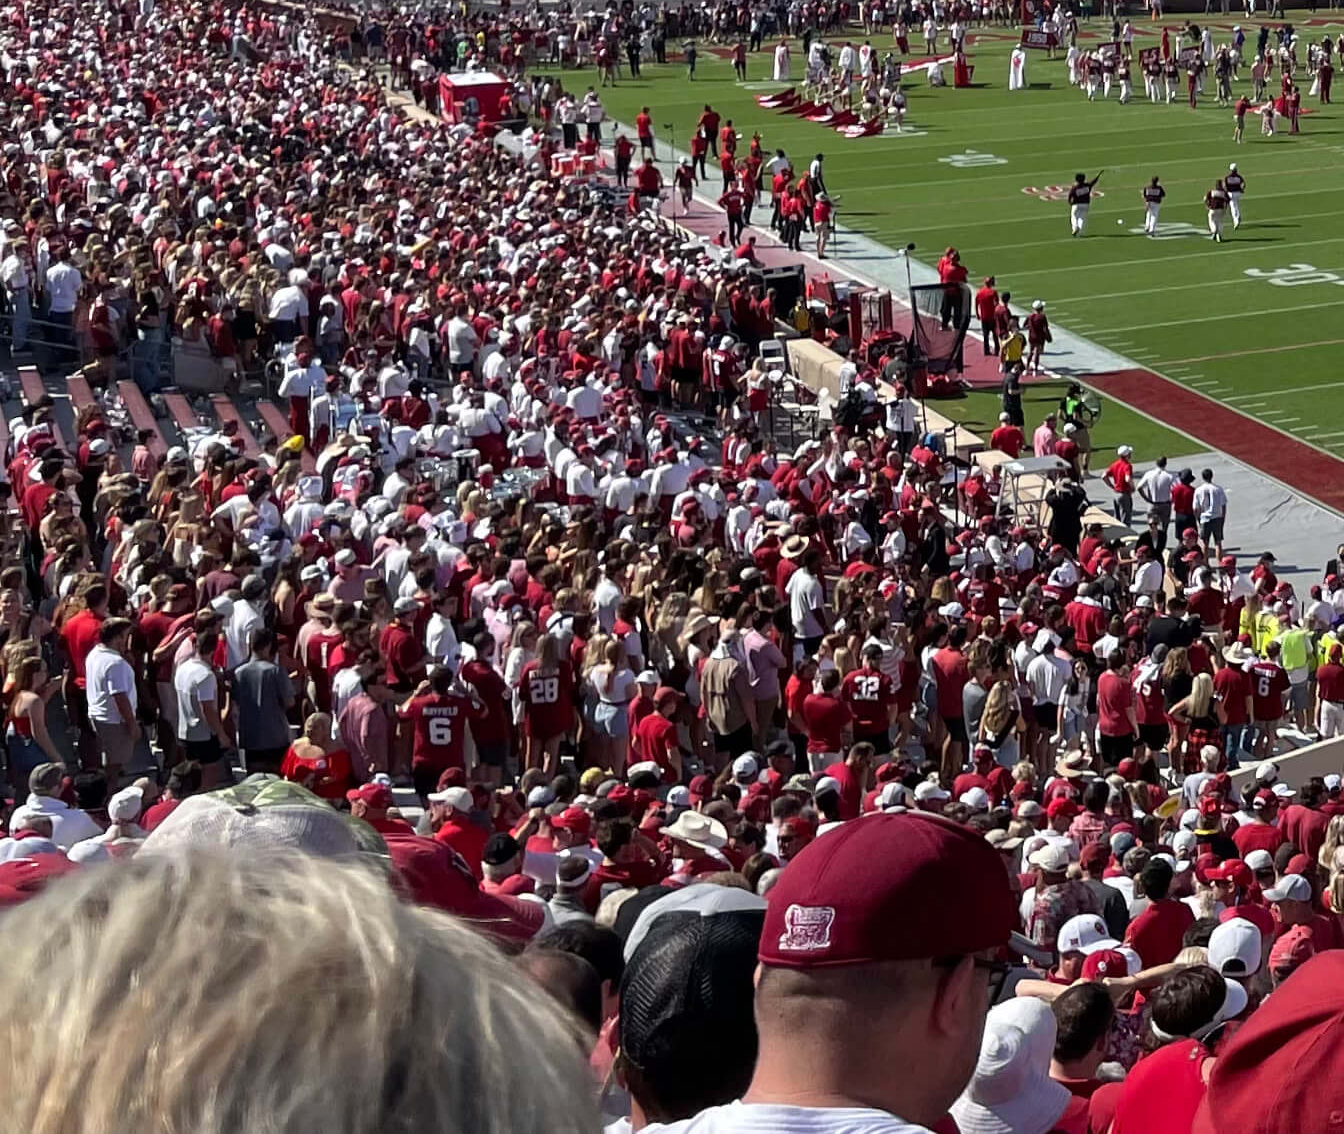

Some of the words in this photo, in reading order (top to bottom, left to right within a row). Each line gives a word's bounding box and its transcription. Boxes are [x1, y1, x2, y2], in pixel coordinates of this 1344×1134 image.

[1243, 263, 1342, 287] 30
[530, 677, 559, 704] 28
[853, 675, 880, 701] 32
[1258, 676, 1270, 697] 6
[429, 717, 452, 746] 6
